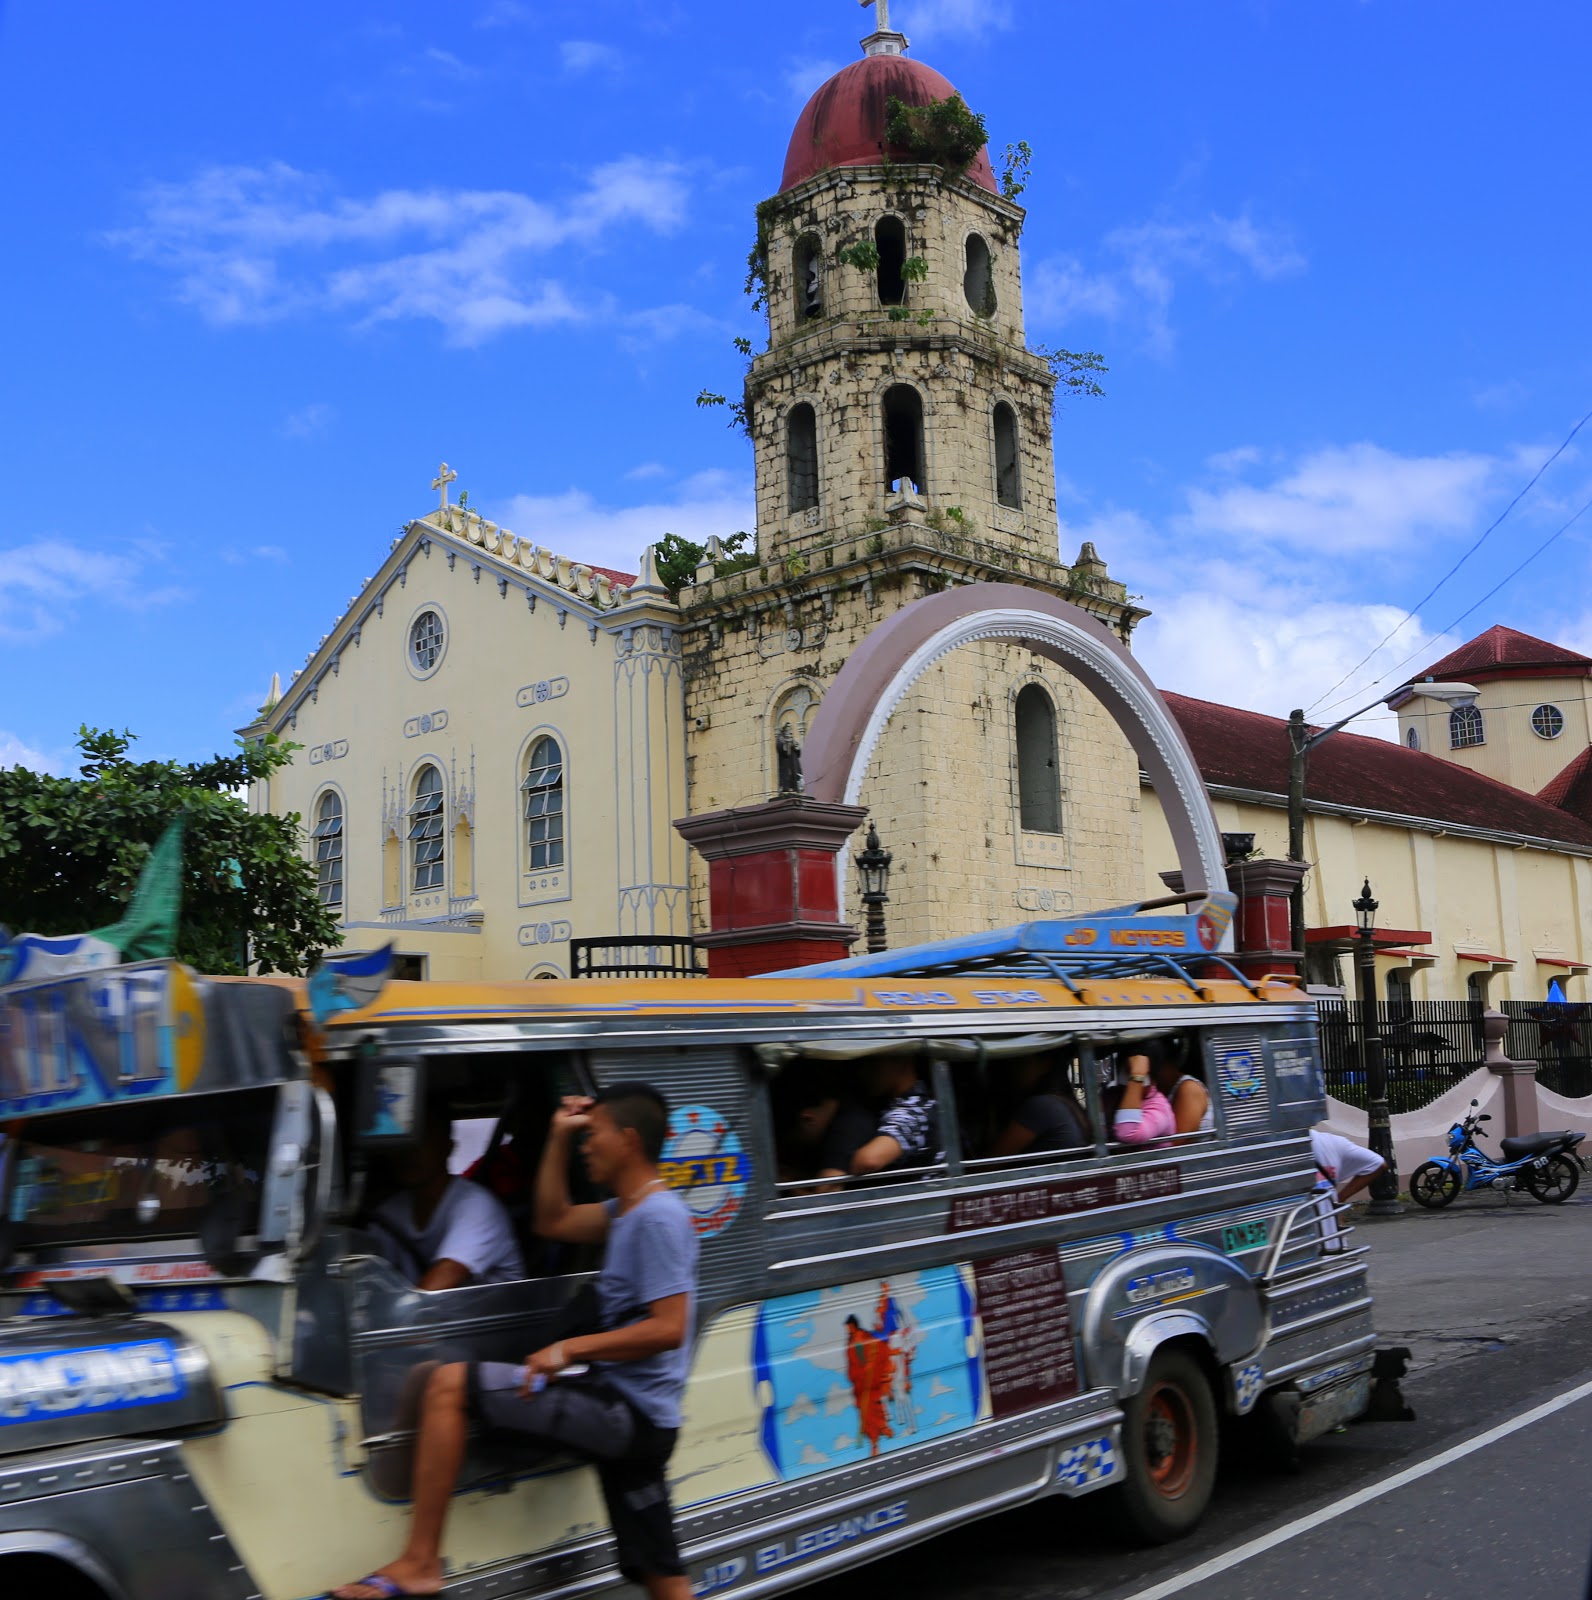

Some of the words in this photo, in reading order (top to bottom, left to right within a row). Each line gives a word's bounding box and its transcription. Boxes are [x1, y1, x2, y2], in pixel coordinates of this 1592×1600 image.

[1065, 928, 1097, 946] JD
[1110, 929, 1186, 947] MOTORS
[872, 990, 958, 1006] ROAD
[970, 989, 1049, 1005] STAR
[1532, 1156, 1550, 1170] 88
[690, 1556, 747, 1598] JD
[755, 1499, 909, 1575] ELEGANCE
